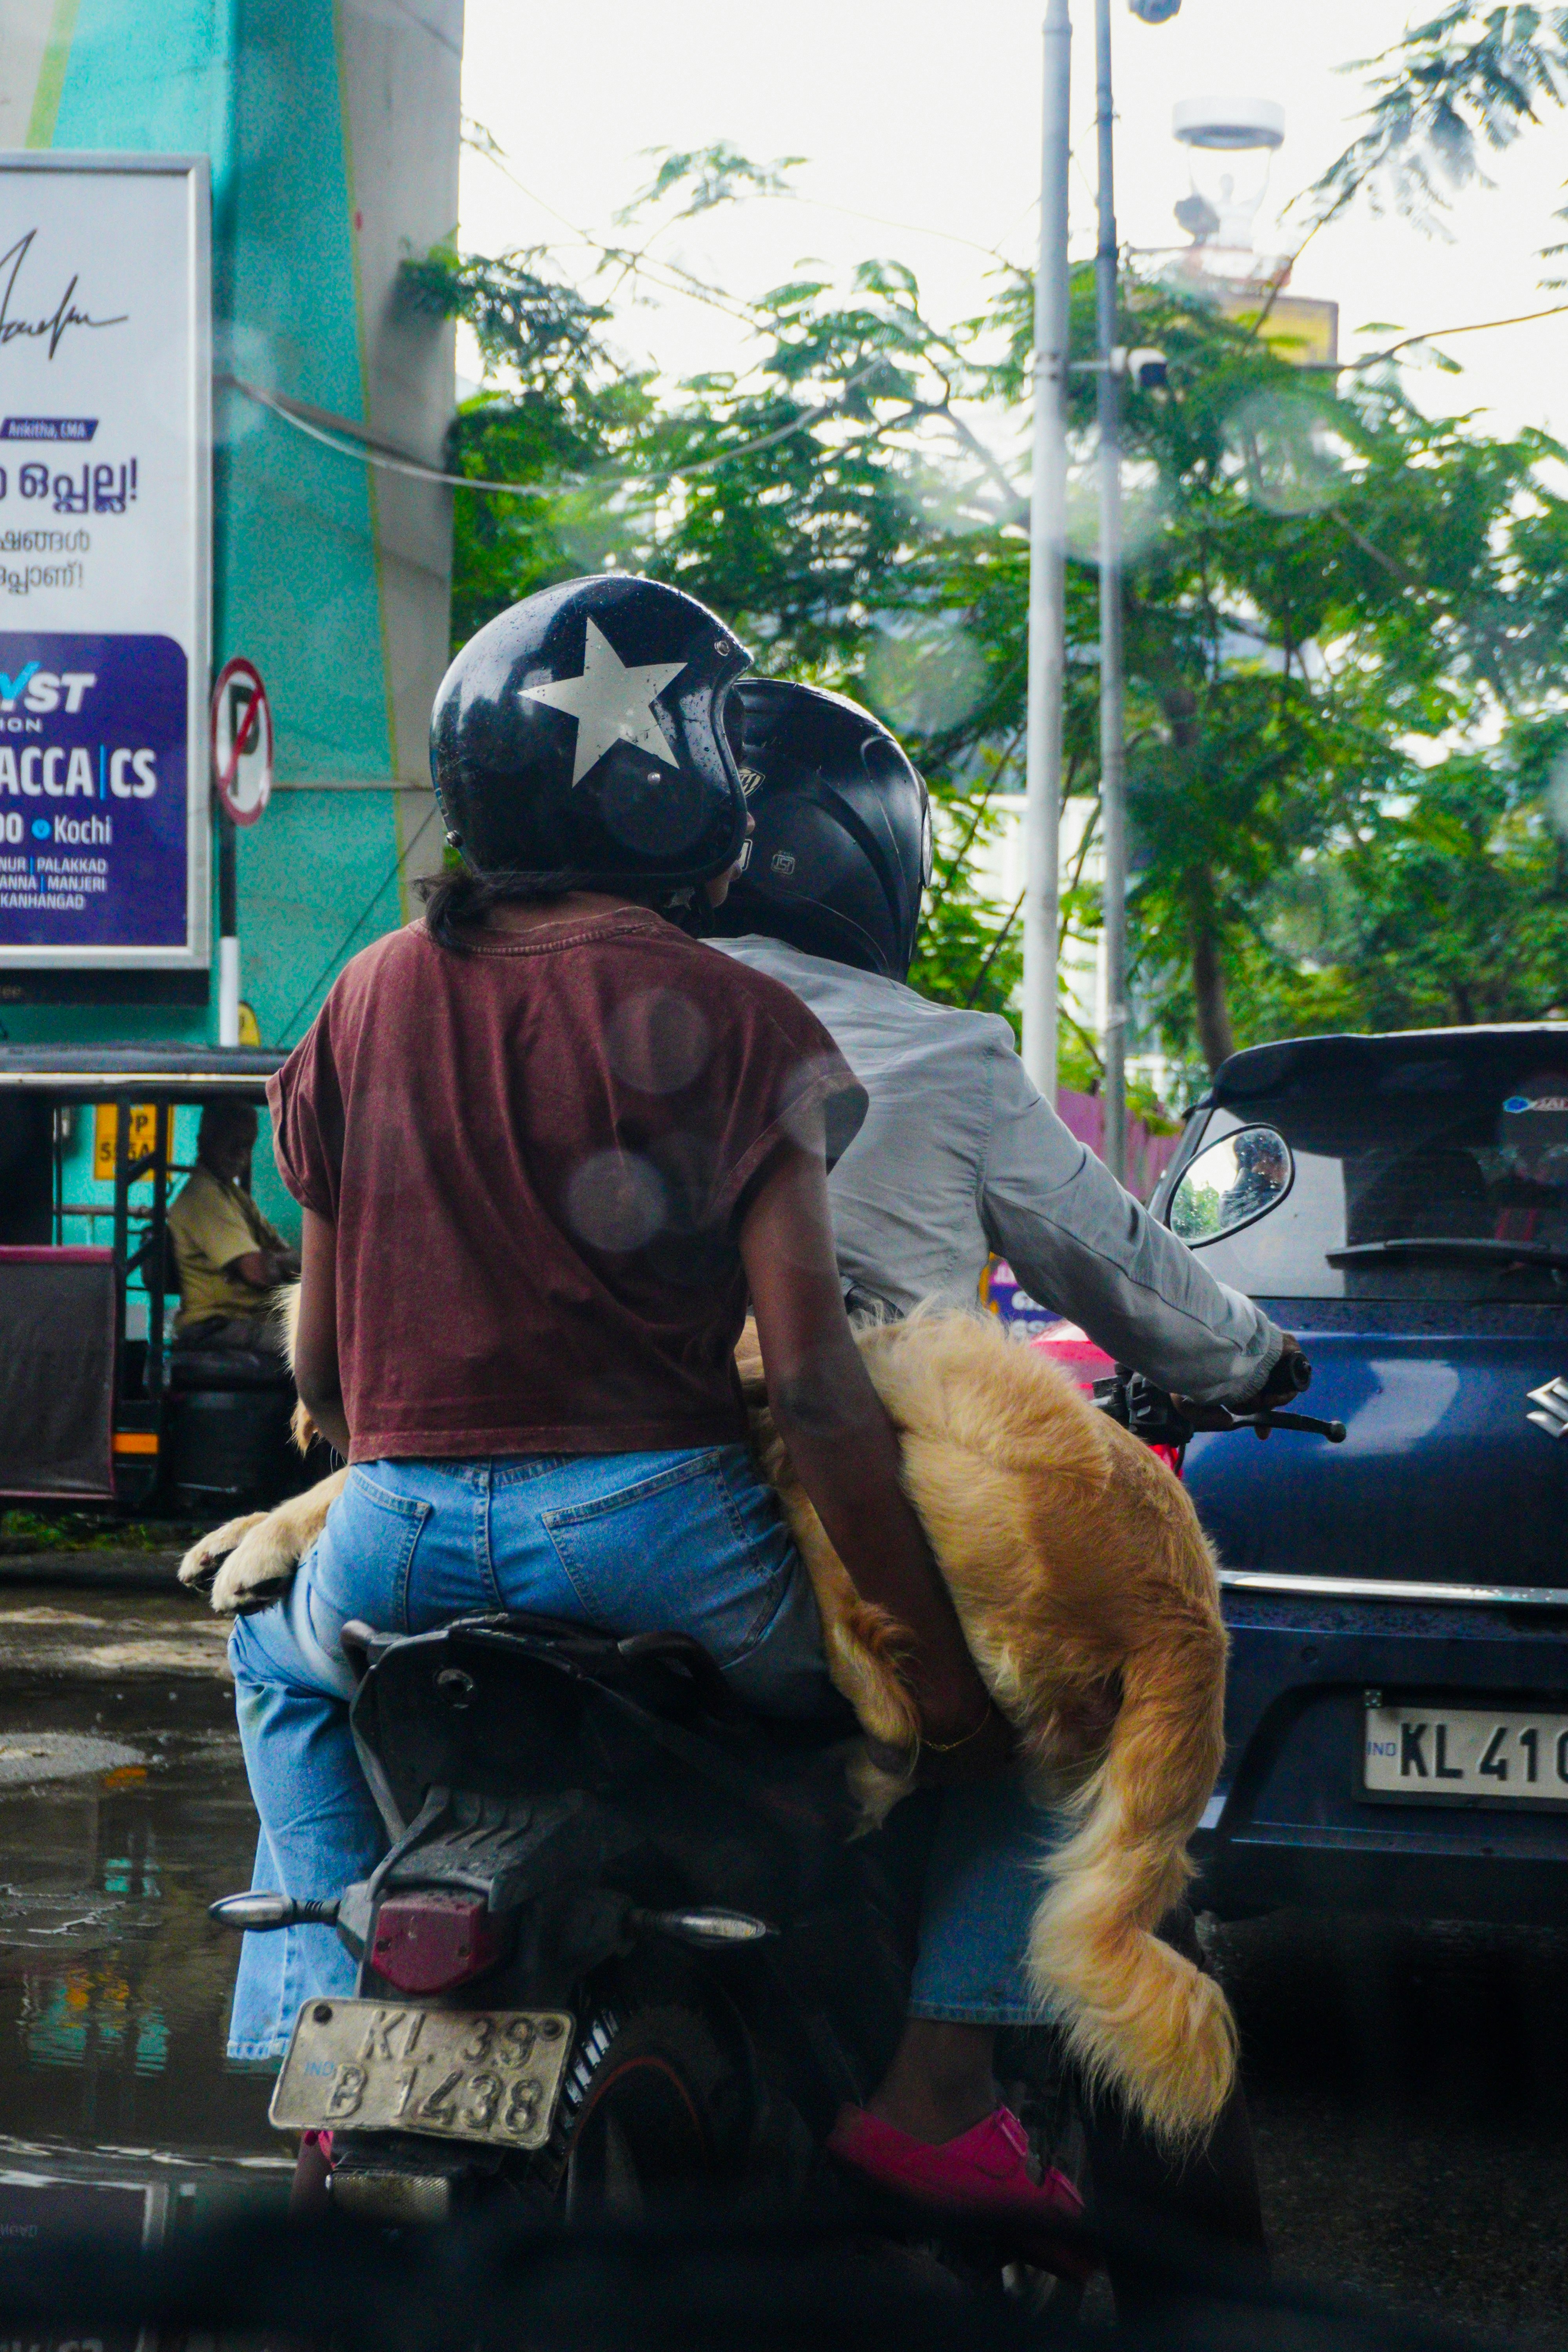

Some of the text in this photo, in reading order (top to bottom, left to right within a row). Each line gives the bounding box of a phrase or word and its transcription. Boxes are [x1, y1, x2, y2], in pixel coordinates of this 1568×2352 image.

[110, 748, 156, 799] CS
[54, 815, 113, 845] Kochi
[37, 856, 109, 875] PALAKKAD
[47, 875, 107, 893] MANJERI
[1401, 1723, 1464, 1779] KL
[462, 2016, 534, 2069] 39
[304, 2061, 334, 2077] IND
[326, 2063, 543, 2134] B 1438
